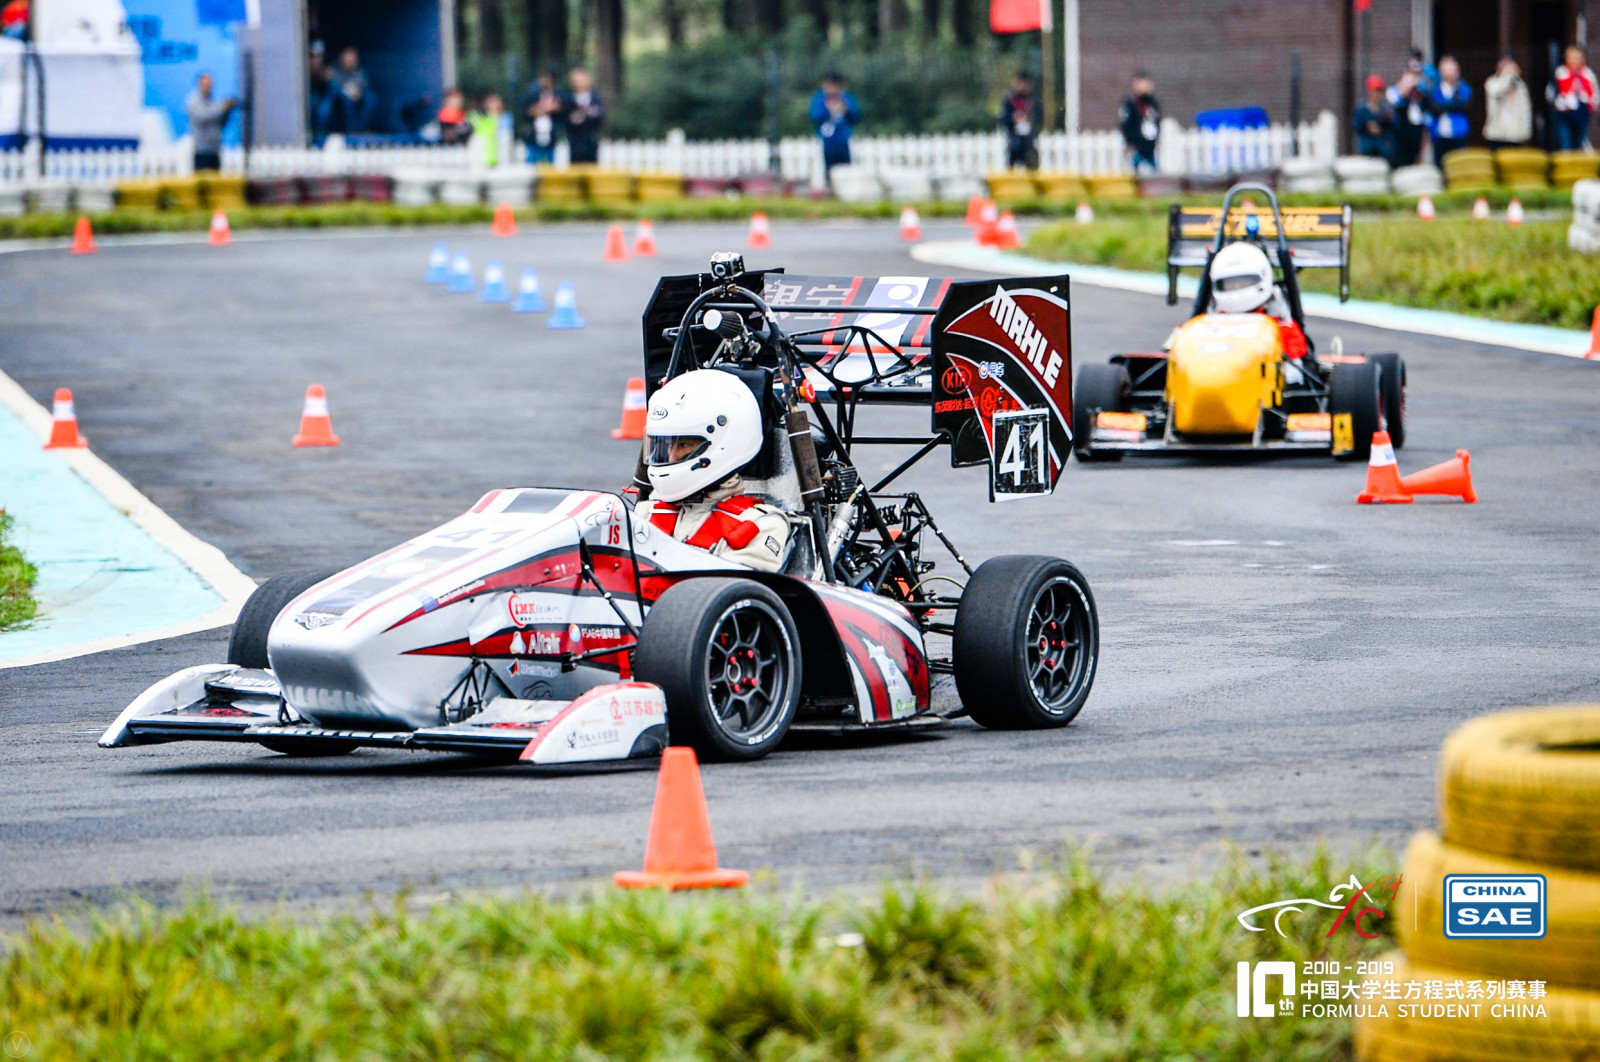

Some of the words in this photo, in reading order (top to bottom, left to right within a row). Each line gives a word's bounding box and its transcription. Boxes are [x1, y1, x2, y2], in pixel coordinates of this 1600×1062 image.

[989, 284, 1063, 389] MAHLE
[1000, 423, 1046, 486] 41
[434, 528, 526, 544] 41
[528, 631, 560, 654] Altair
